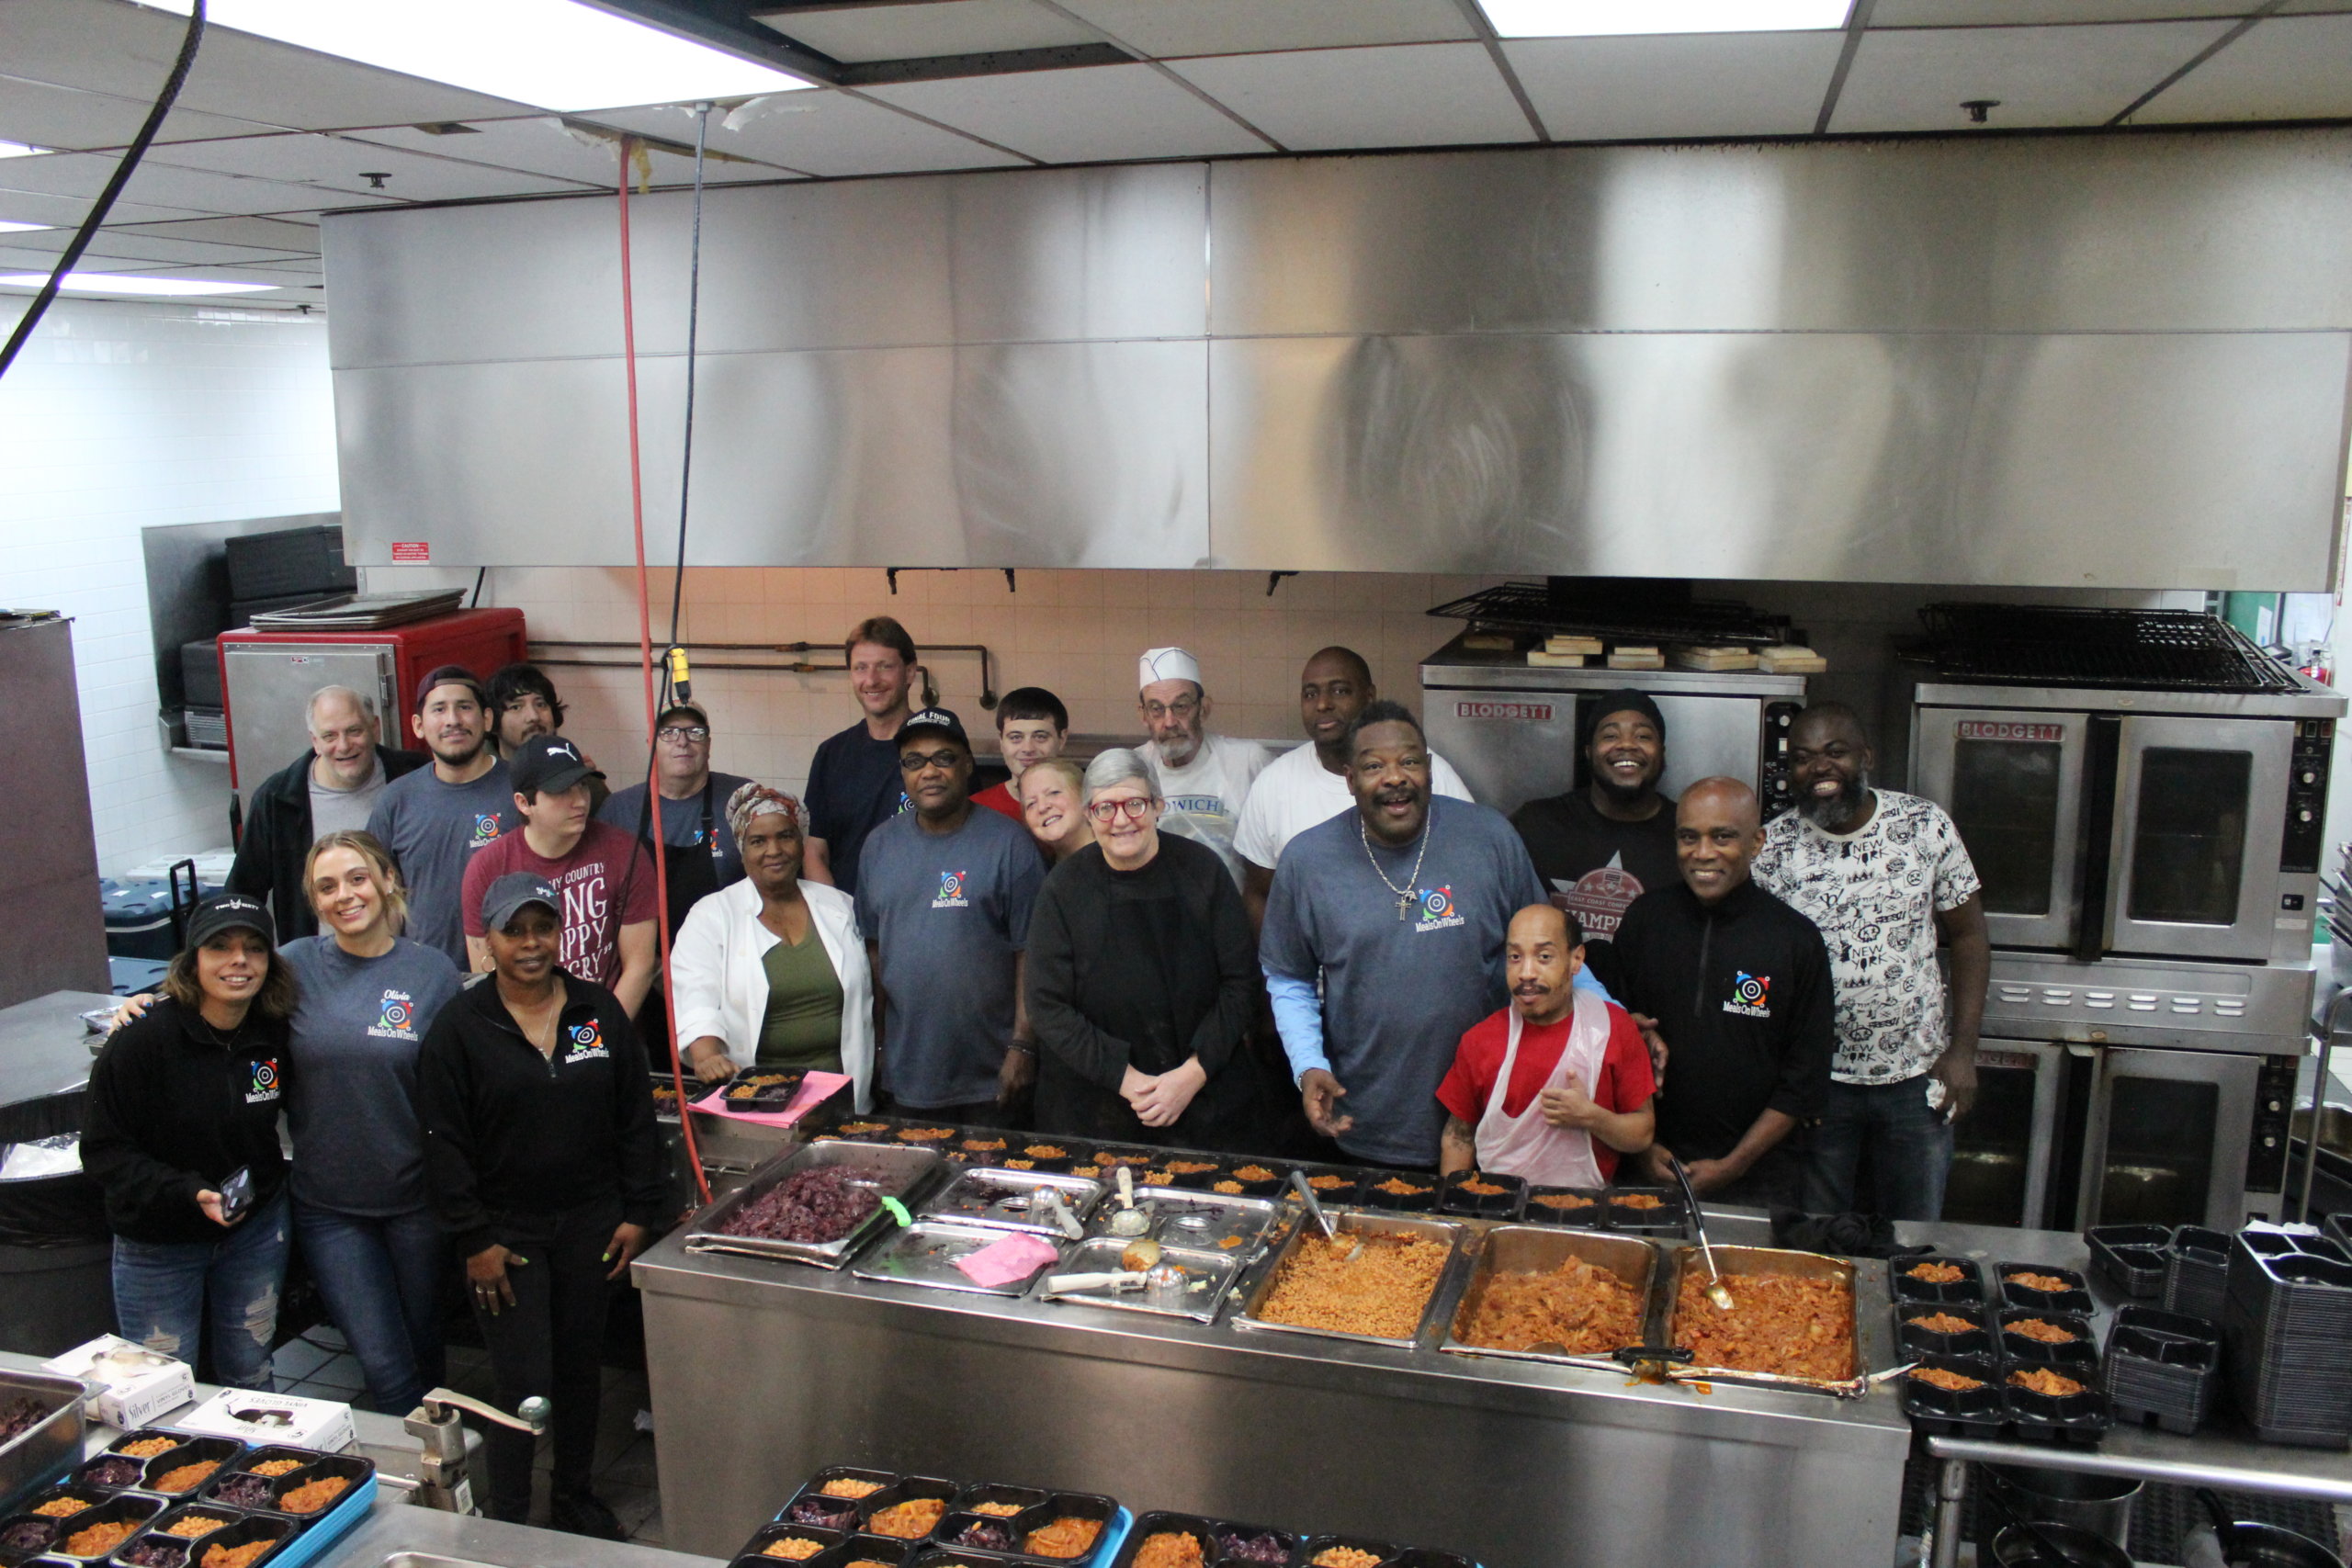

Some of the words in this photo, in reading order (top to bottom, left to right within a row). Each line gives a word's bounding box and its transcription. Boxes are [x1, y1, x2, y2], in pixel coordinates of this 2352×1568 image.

[929, 711, 950, 724] FOUR
[1461, 704, 1548, 719] BLODGETT
[1962, 722, 2058, 739] BLODGETT
[1852, 839, 1883, 854] NEW
[1851, 846, 1890, 866] YORK
[565, 863, 605, 884] COUNTRY
[1570, 895, 1585, 903] EAST
[1587, 897, 1606, 906] COAST
[1415, 919, 1434, 932] Meals
[1441, 914, 1464, 928] Wheels
[1852, 944, 1883, 960] NEW
[1851, 952, 1887, 972] YORK
[383, 989, 412, 1000] Olivia
[1723, 1000, 1742, 1014] Meals
[368, 1026, 387, 1037] Meals
[386, 1027, 397, 1038] On
[396, 1029, 419, 1042] Wheels
[1841, 1044, 1874, 1053] NEW
[565, 1051, 584, 1064] Meals
[245, 1091, 264, 1103] Meals
[129, 1403, 150, 1420] Silver
